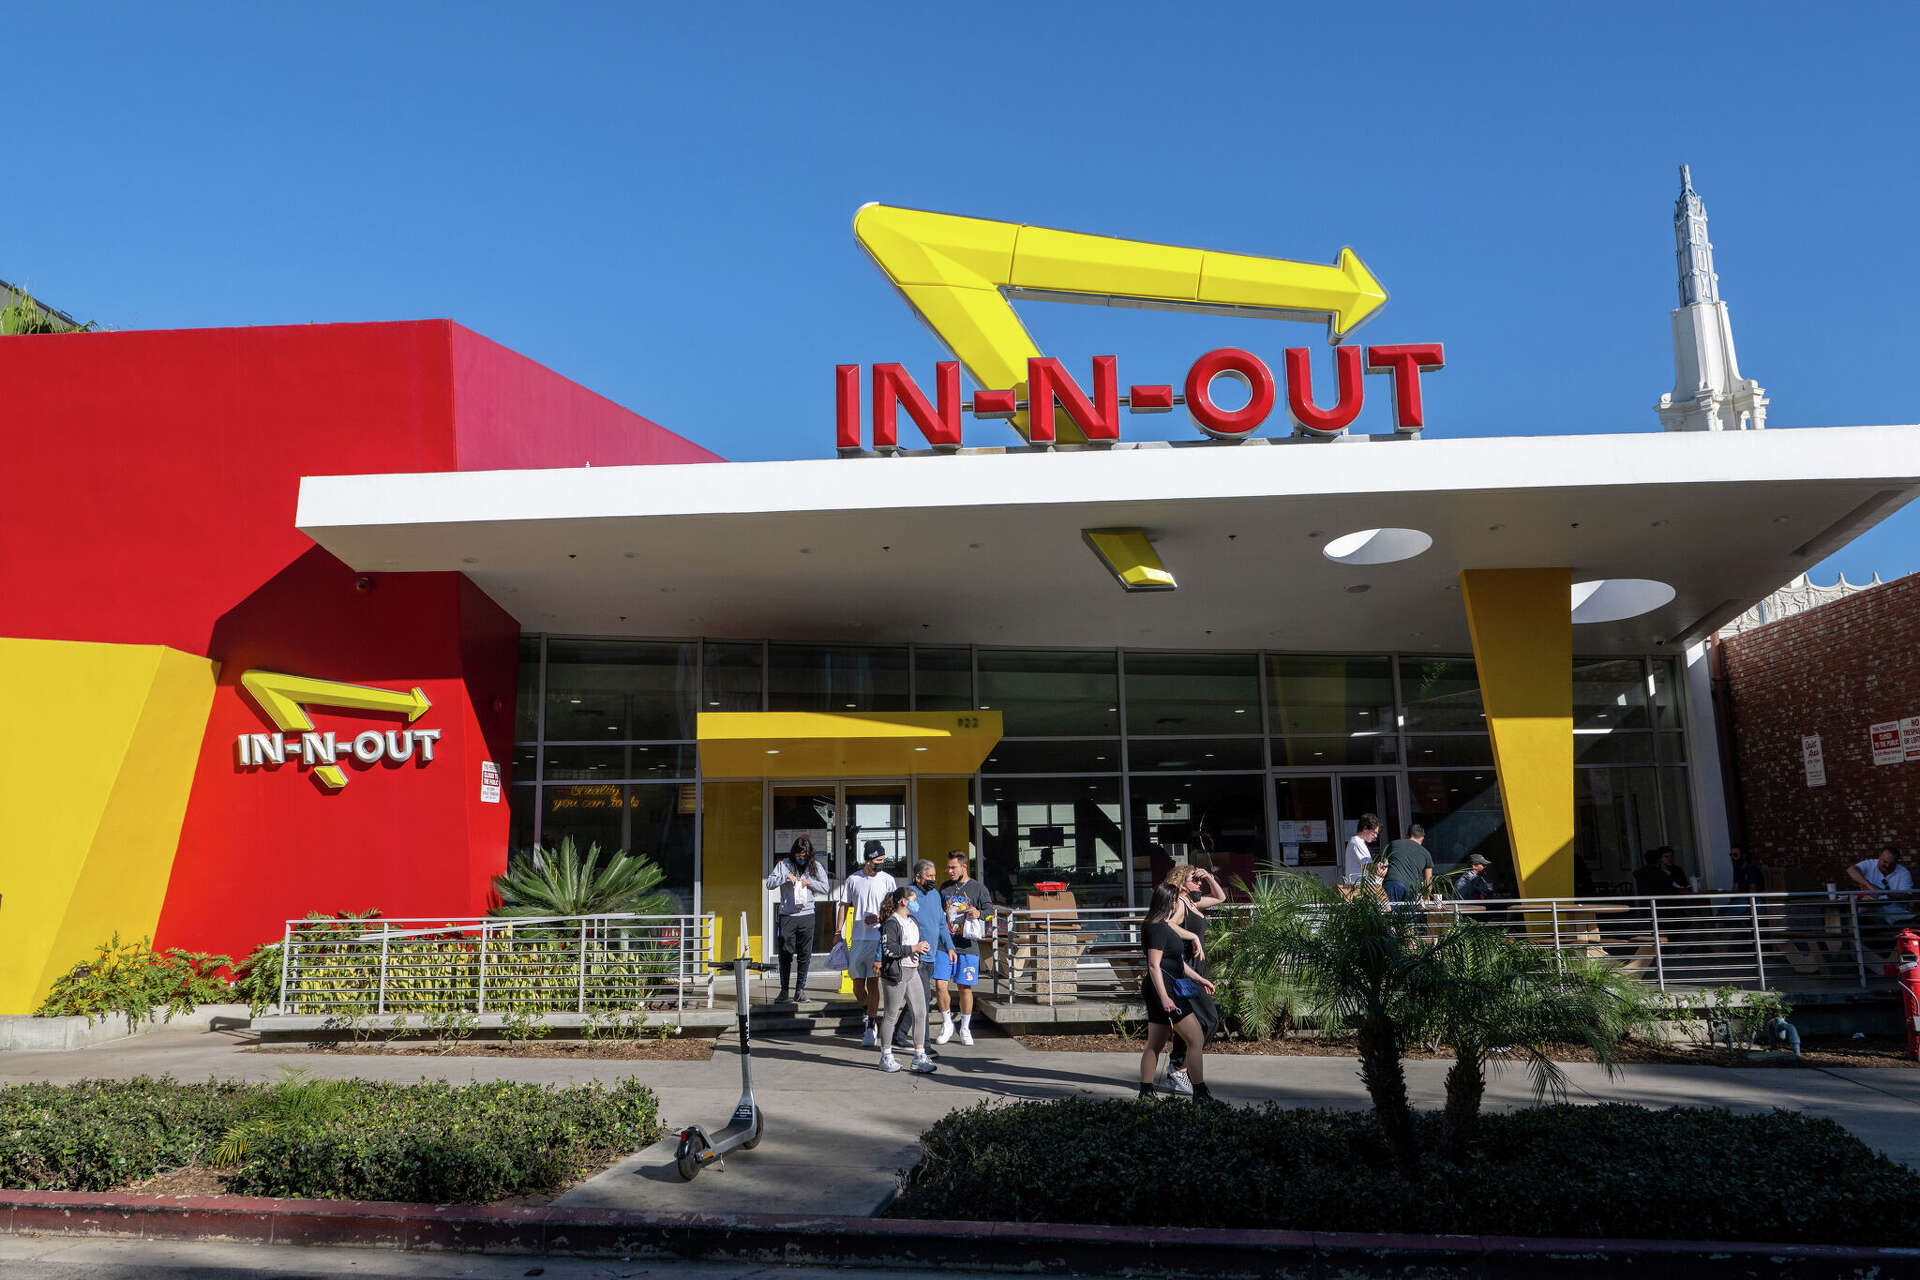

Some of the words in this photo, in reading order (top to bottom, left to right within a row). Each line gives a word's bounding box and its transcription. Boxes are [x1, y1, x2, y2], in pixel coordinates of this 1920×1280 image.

[1694, 223, 1711, 298] FOX
[836, 342, 1445, 449] IN-N-OUT
[237, 728, 442, 766] IN-N-OUT
[552, 799, 578, 811] you
